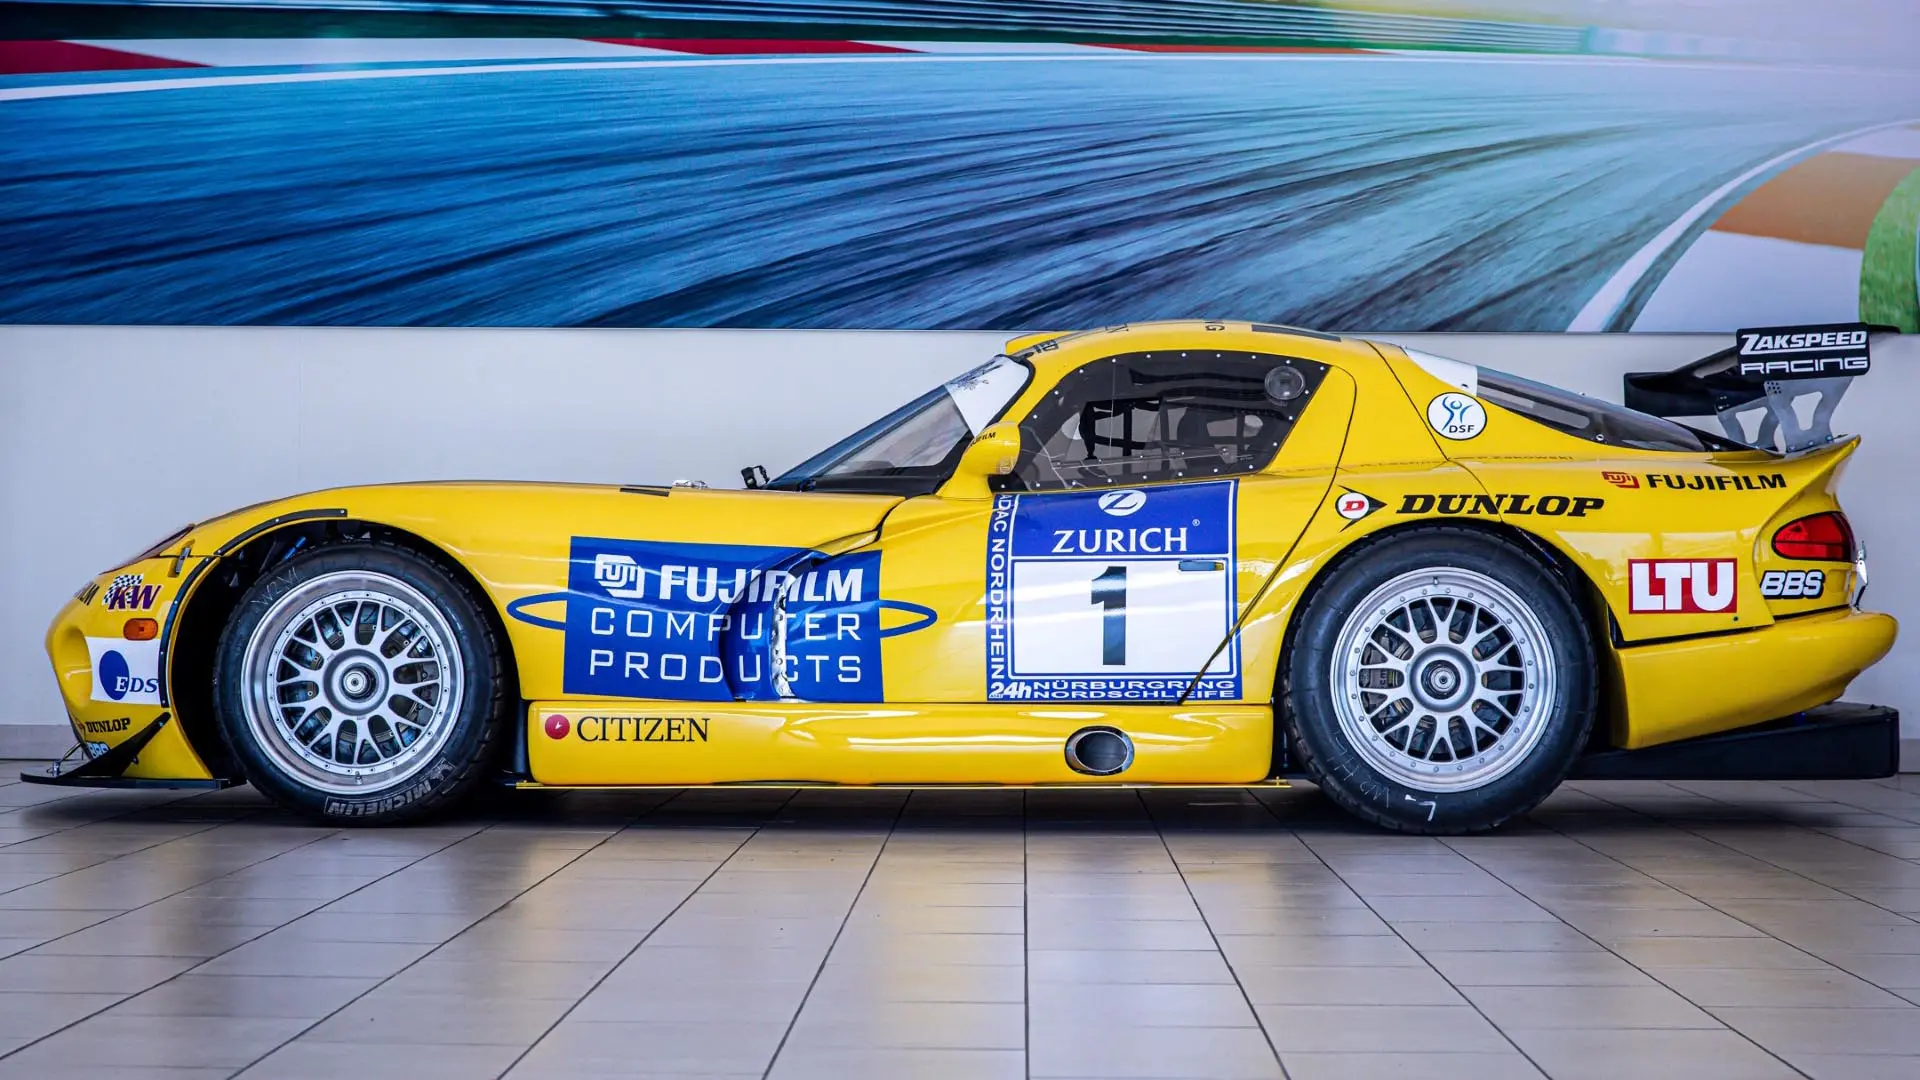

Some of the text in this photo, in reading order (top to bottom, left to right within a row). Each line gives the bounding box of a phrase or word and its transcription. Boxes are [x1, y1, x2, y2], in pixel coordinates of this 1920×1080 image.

[1740, 331, 1867, 355] ZAKSPEED
[1741, 357, 1868, 375] RACING
[1449, 424, 1475, 433] DSF
[1646, 474, 1787, 490] FUJIFILM
[992, 495, 1013, 532] ADAC
[1396, 493, 1604, 517] DUNLOP
[1052, 527, 1187, 553] ZURICH
[659, 563, 864, 604] FUJIFILM
[1632, 561, 1735, 612] LTU
[1760, 571, 1823, 597] BBS
[107, 585, 162, 610] KW
[990, 538, 1006, 679] NORDRHEIN
[1091, 566, 1127, 666] 1
[590, 649, 862, 684] PRODUCTS
[114, 676, 159, 693] EDS
[989, 680, 1235, 699] 24h NÜRBURGRING
[1033, 690, 1235, 698] NORDSCHLEIFE
[85, 717, 131, 733] DUNLOP
[576, 716, 709, 742] CITIZEN
[328, 780, 432, 816] MICHELIN
